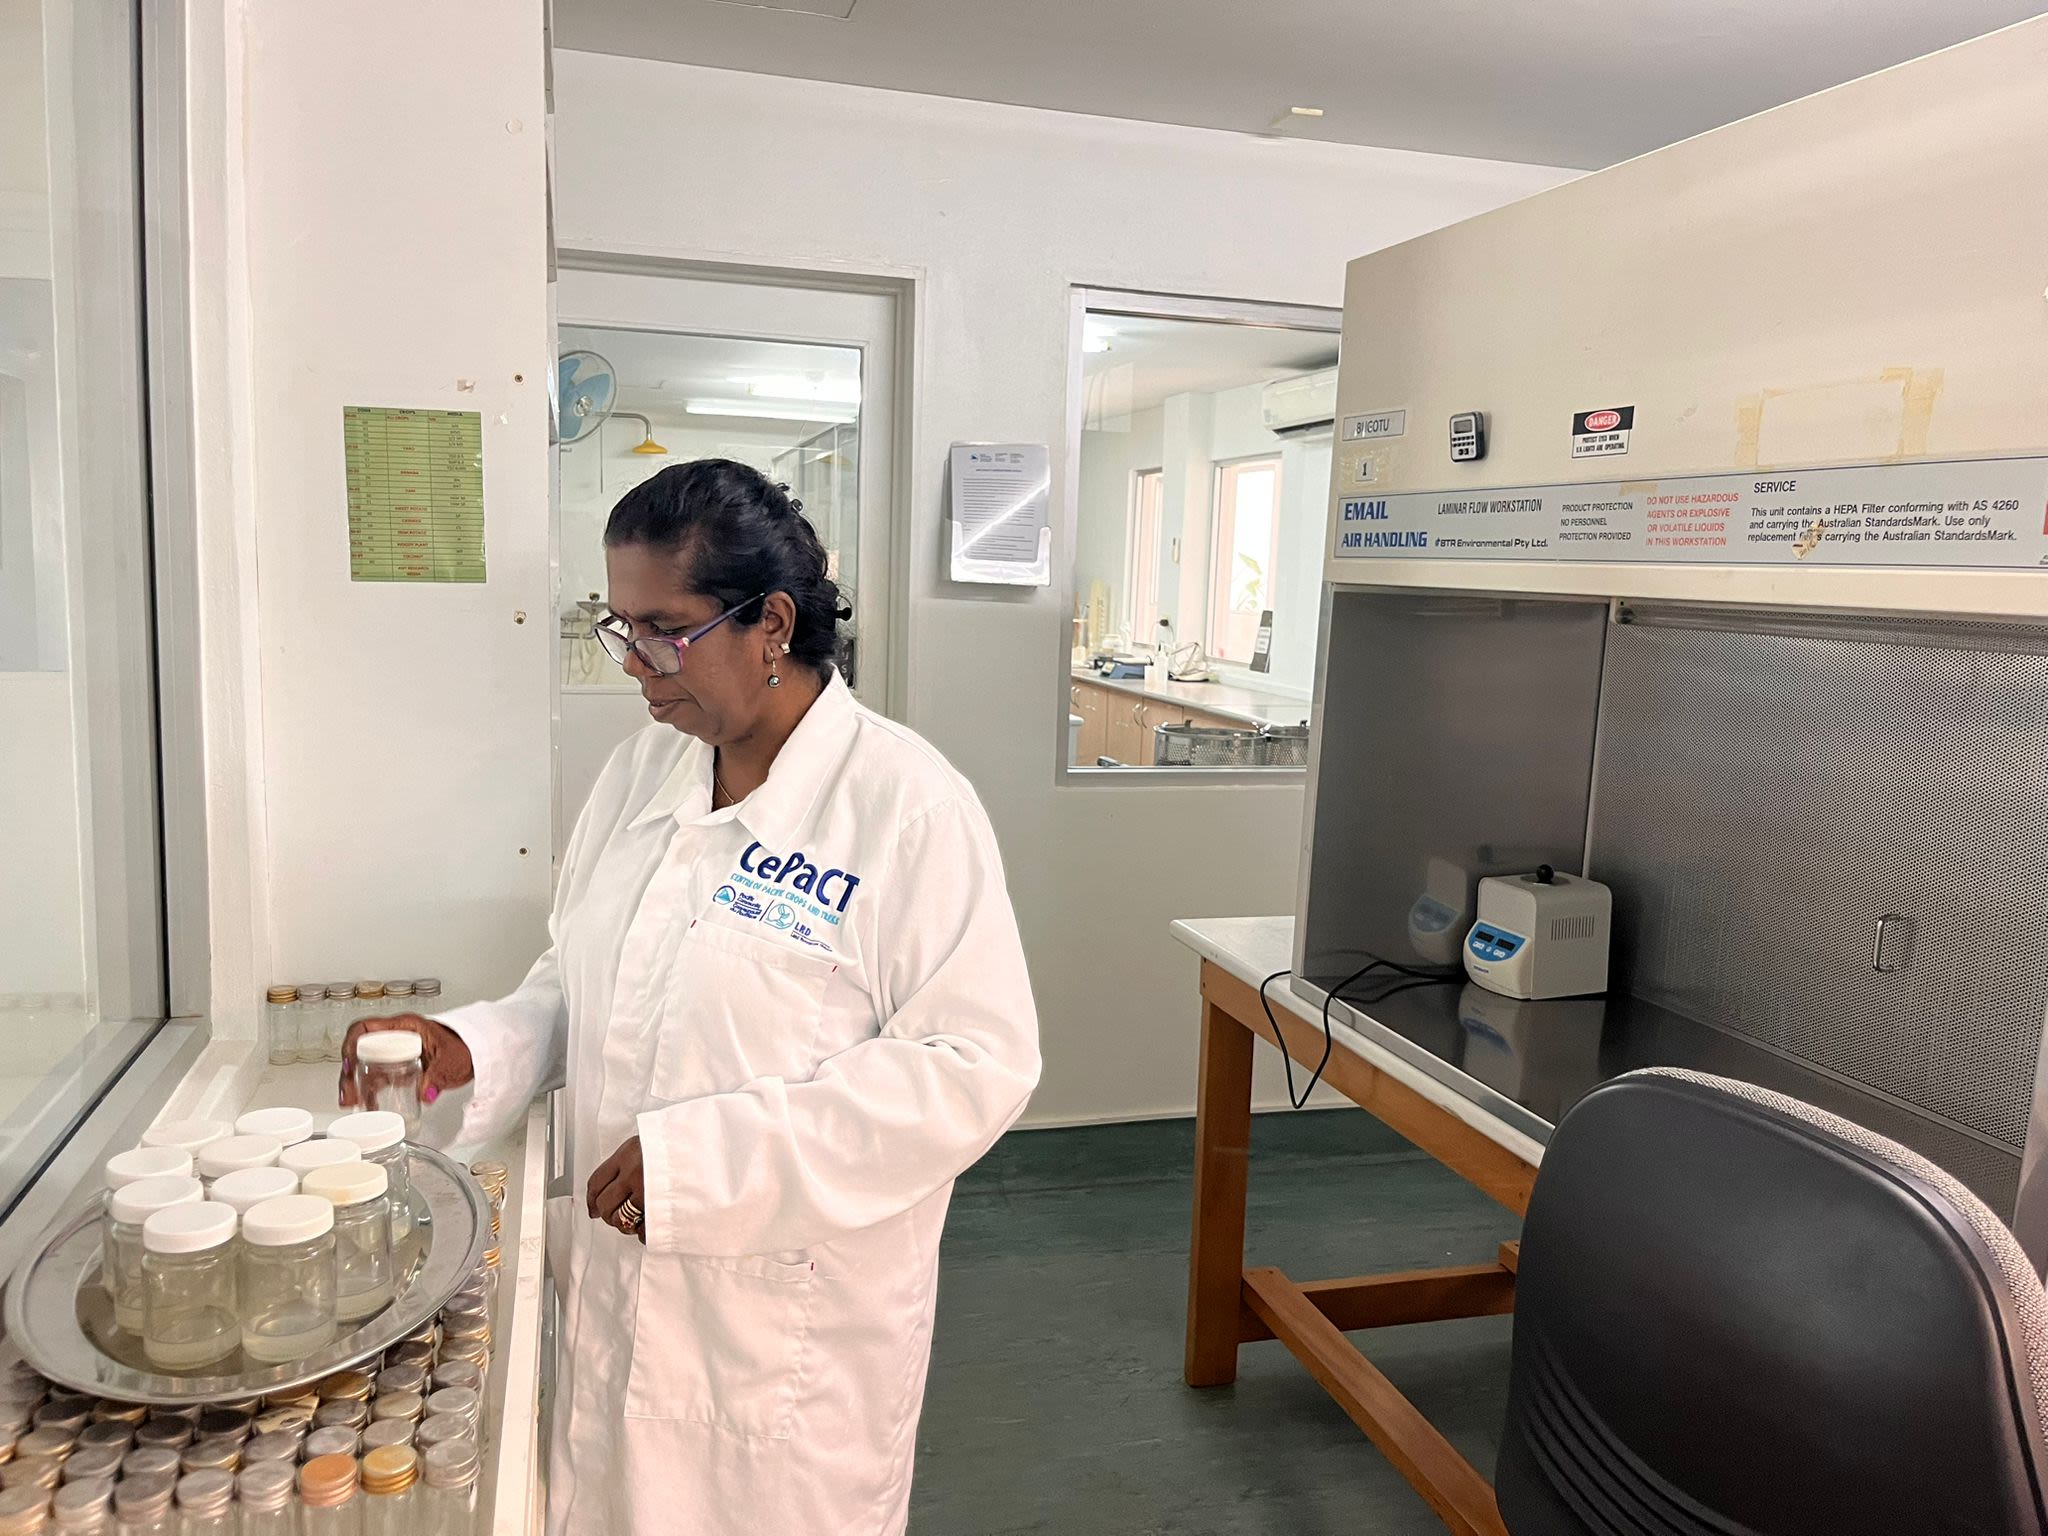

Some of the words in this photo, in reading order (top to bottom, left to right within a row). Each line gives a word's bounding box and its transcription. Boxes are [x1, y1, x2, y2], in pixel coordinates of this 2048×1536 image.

[1588, 414, 1618, 428] DANGER
[1754, 480, 1796, 494] SERVICE
[1647, 496, 1656, 504] DO
[1658, 496, 1674, 504] NOT
[1675, 496, 1690, 504] USE
[1692, 492, 1739, 504] HAZARDOUS
[1344, 501, 1388, 520] EMAIL
[1438, 502, 1467, 514] LAMINAR
[1468, 502, 1488, 514] FLOW
[1490, 498, 1542, 512] WORKSTATION
[1562, 504, 1591, 512] PRODUCT
[1592, 502, 1633, 511] PROTECTION
[1647, 510, 1675, 518] AGENTS
[1676, 509, 1688, 518] OR
[1690, 508, 1730, 518] EXPLOSIVE
[1751, 507, 1767, 516] This
[1770, 507, 1784, 516] unit
[1786, 506, 1822, 516] contains
[1834, 504, 1858, 514] HEPA
[1862, 504, 1886, 514] Filter
[1887, 502, 1944, 514] conforming
[1948, 500, 1968, 511] with
[1972, 500, 1988, 511] AS
[1992, 500, 2020, 510] 4260
[1560, 518, 1570, 526] NO
[1570, 518, 1608, 526] PERSONNEL
[1648, 524, 1658, 532] OR
[1660, 523, 1692, 532] VOLATILE
[1694, 522, 1725, 532] LIQUIDS
[1749, 520, 1764, 529] and
[1766, 520, 1799, 530] carrying
[1817, 518, 1861, 528] Australian
[1944, 516, 1965, 526] Use
[1968, 516, 1991, 528] only
[1341, 533, 1362, 548] AIR
[1364, 532, 1428, 548] HANDLING
[1457, 538, 1513, 547] Environmental
[1514, 538, 1530, 548] Pty
[1532, 538, 1548, 547] Ltd.
[1560, 532, 1598, 540] PROTECTION
[1599, 532, 1632, 540] PROVIDED
[1646, 538, 1652, 546] IN
[1656, 538, 1670, 546] THIS
[1672, 538, 1726, 546] WORKSTATION
[1748, 532, 1796, 543] replacement
[1824, 532, 1860, 543] carrying
[1864, 532, 1880, 540] the
[1882, 530, 1930, 540] Australian
[740, 840, 861, 912] CePaCT
[753, 882, 763, 890] OF
[785, 892, 808, 908] CROPS
[794, 922, 812, 936] LRD
